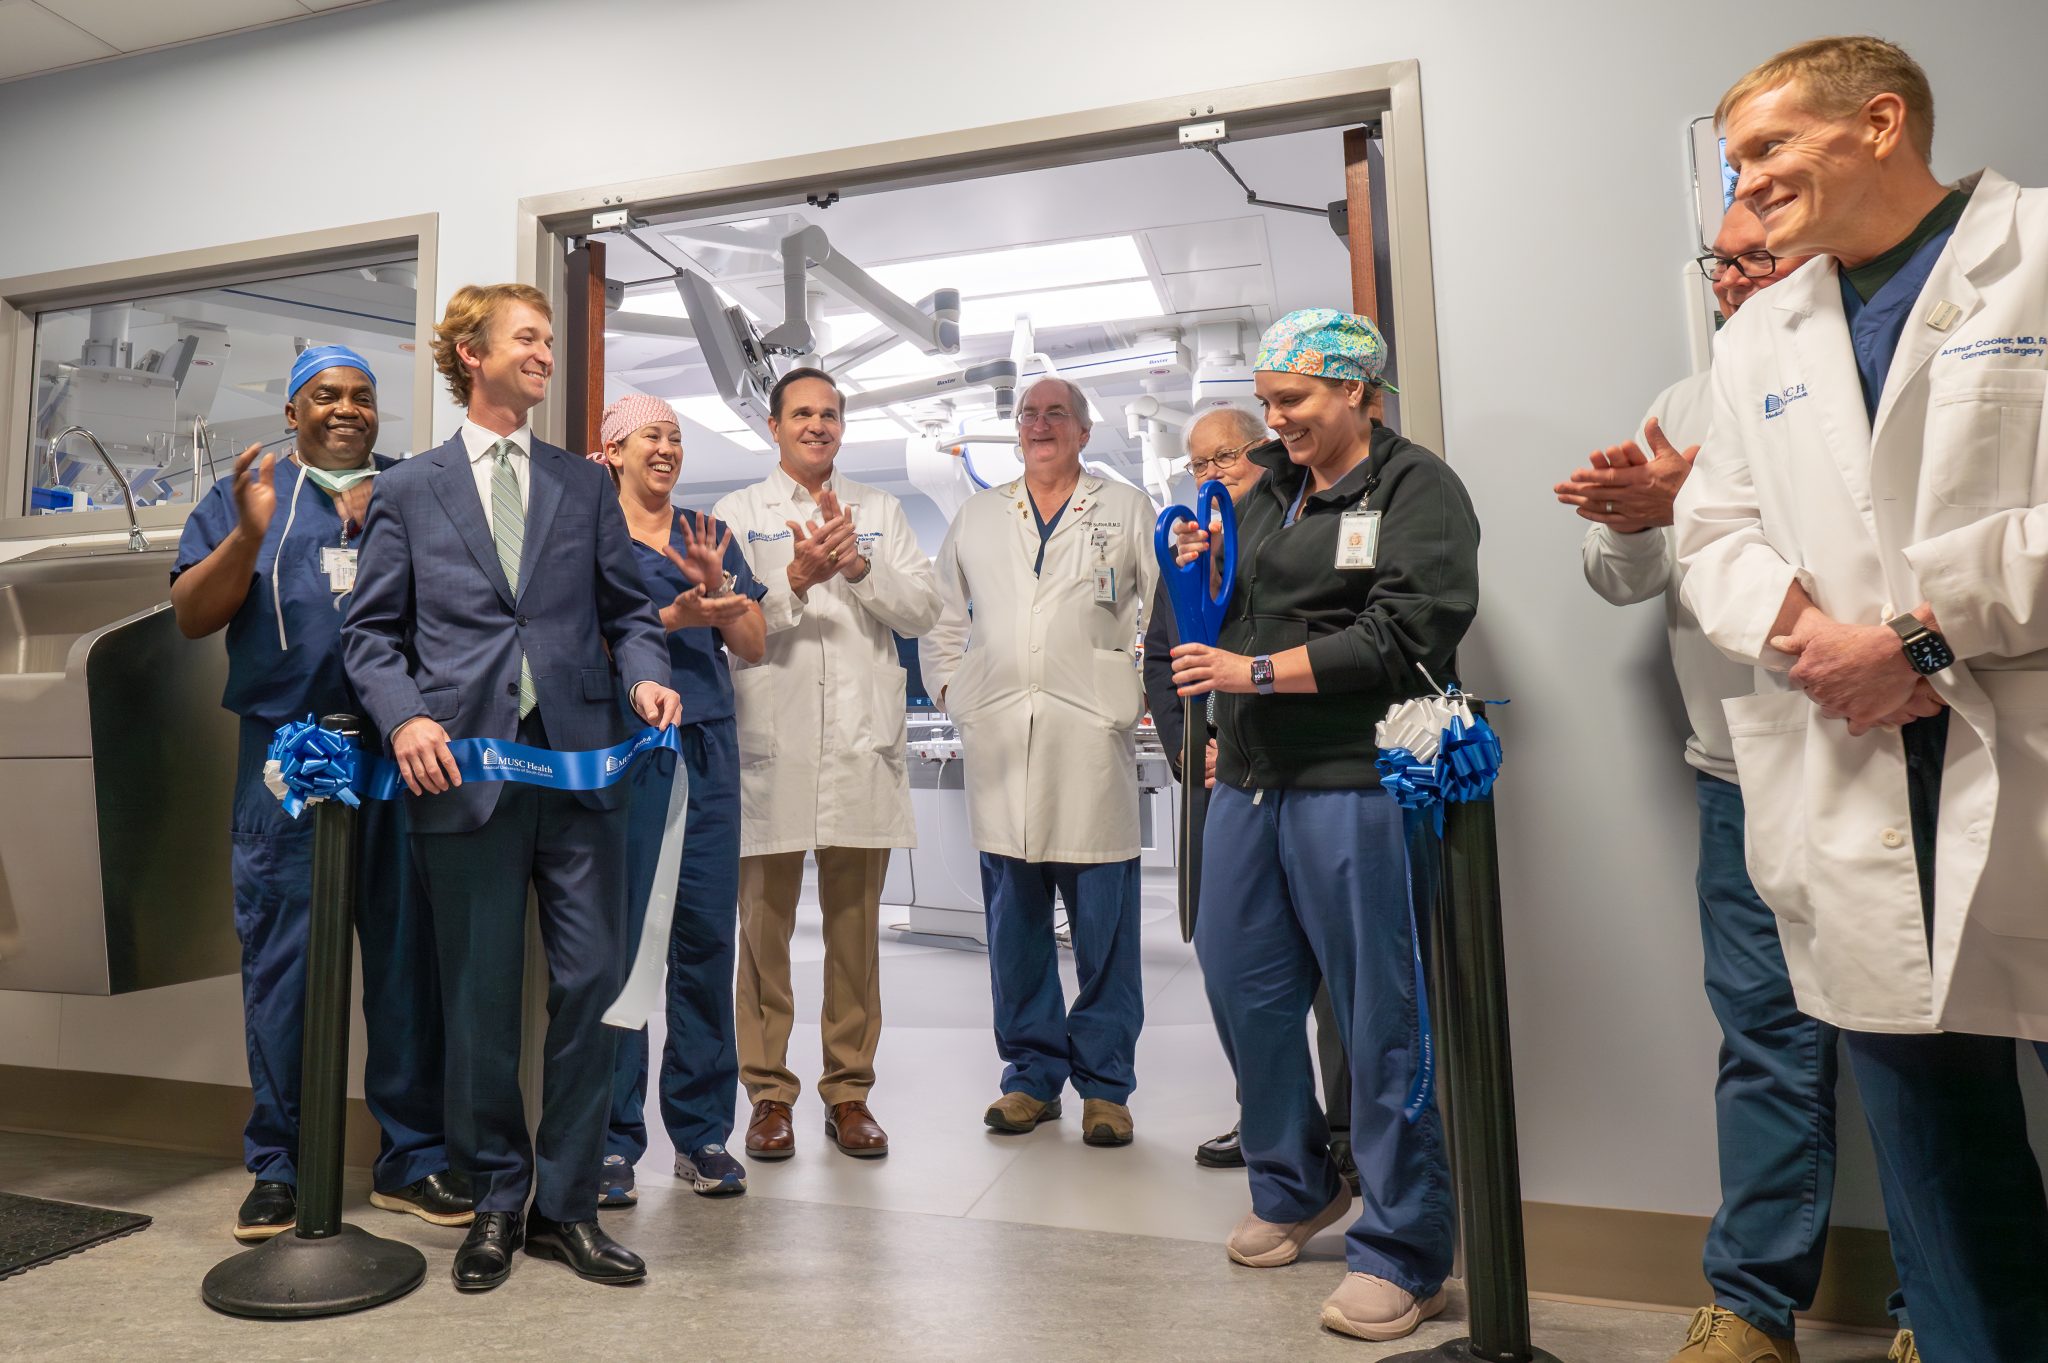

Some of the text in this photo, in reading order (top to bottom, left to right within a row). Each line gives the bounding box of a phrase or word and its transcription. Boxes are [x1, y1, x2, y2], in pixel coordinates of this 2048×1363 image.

[1941, 344, 1973, 356] Arthur
[1961, 346, 2044, 360] General Surgery
[498, 756, 553, 774] MUSC Health
